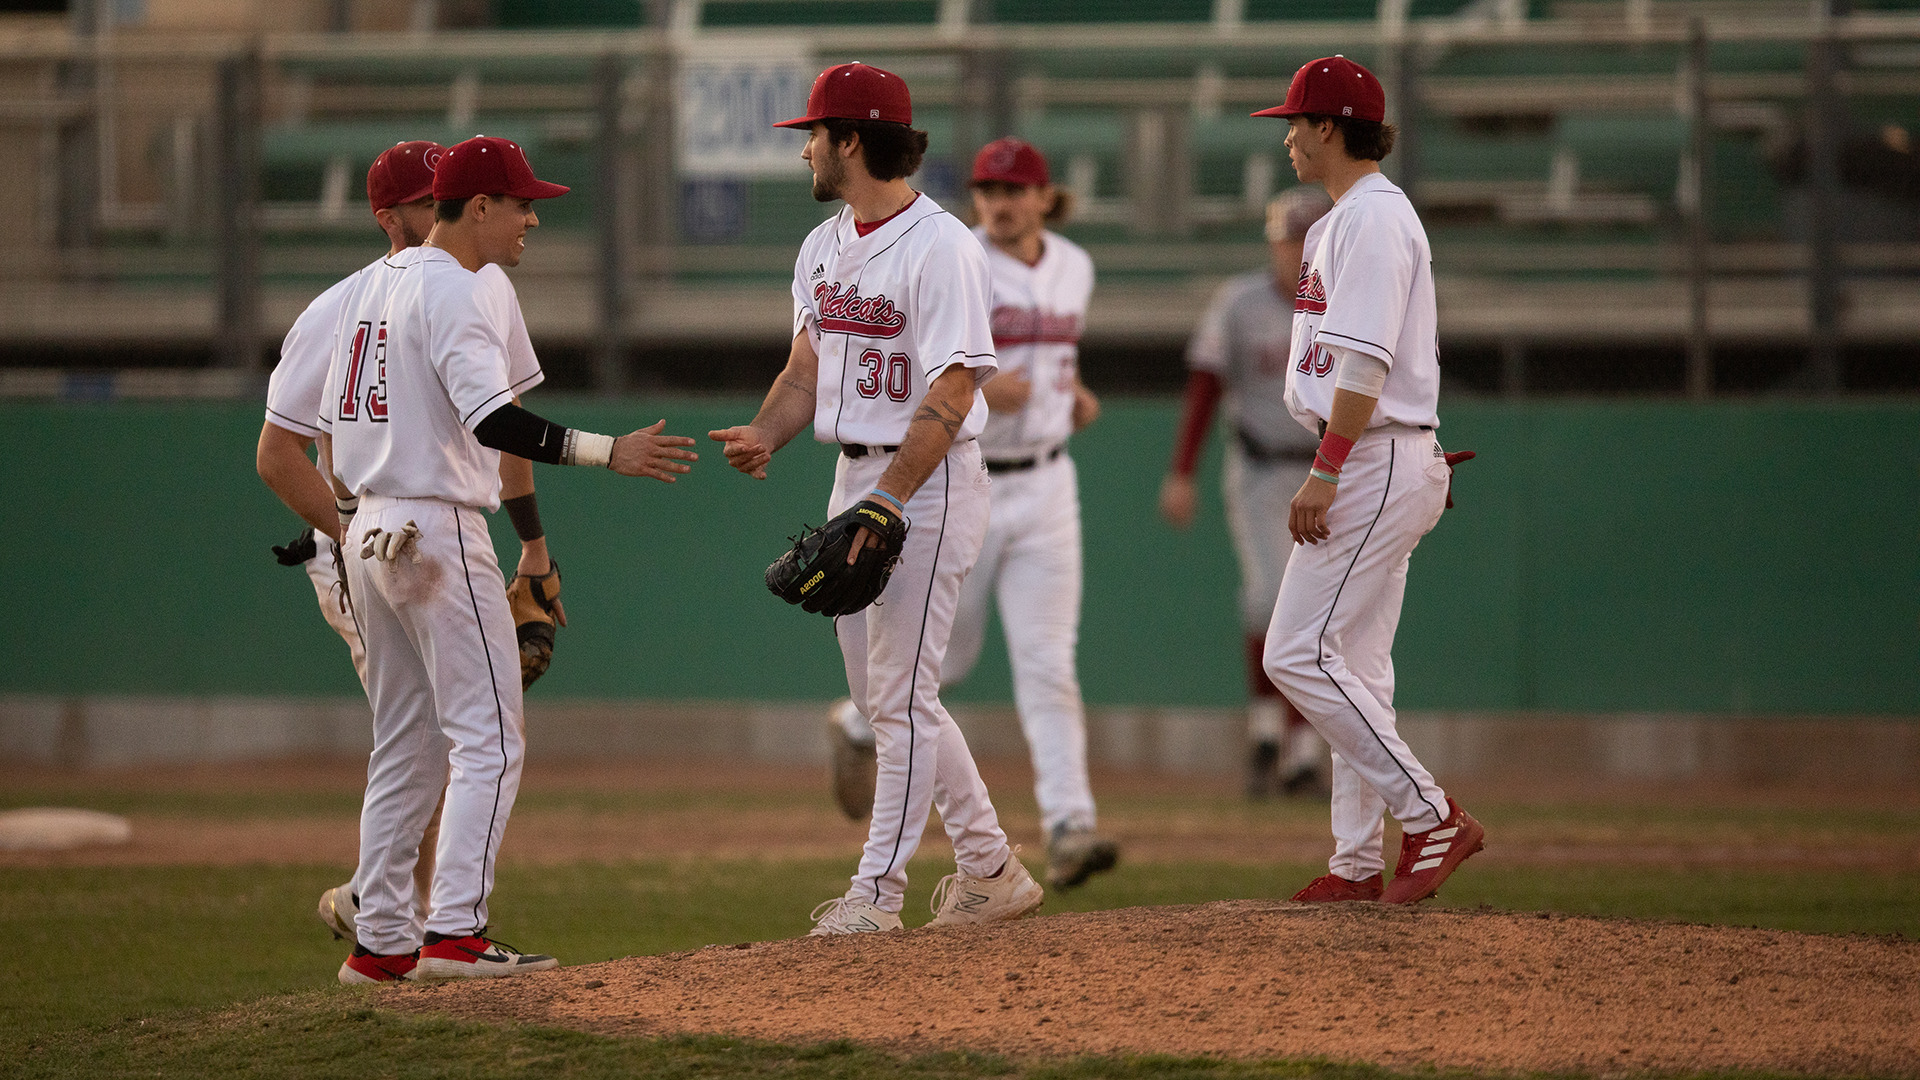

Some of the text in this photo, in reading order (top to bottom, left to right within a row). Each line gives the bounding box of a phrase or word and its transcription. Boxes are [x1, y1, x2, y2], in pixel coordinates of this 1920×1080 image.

[814, 281, 906, 336] Wldcats
[856, 348, 911, 402] 30
[856, 508, 888, 526] Wilson
[800, 570, 825, 595] A2000
